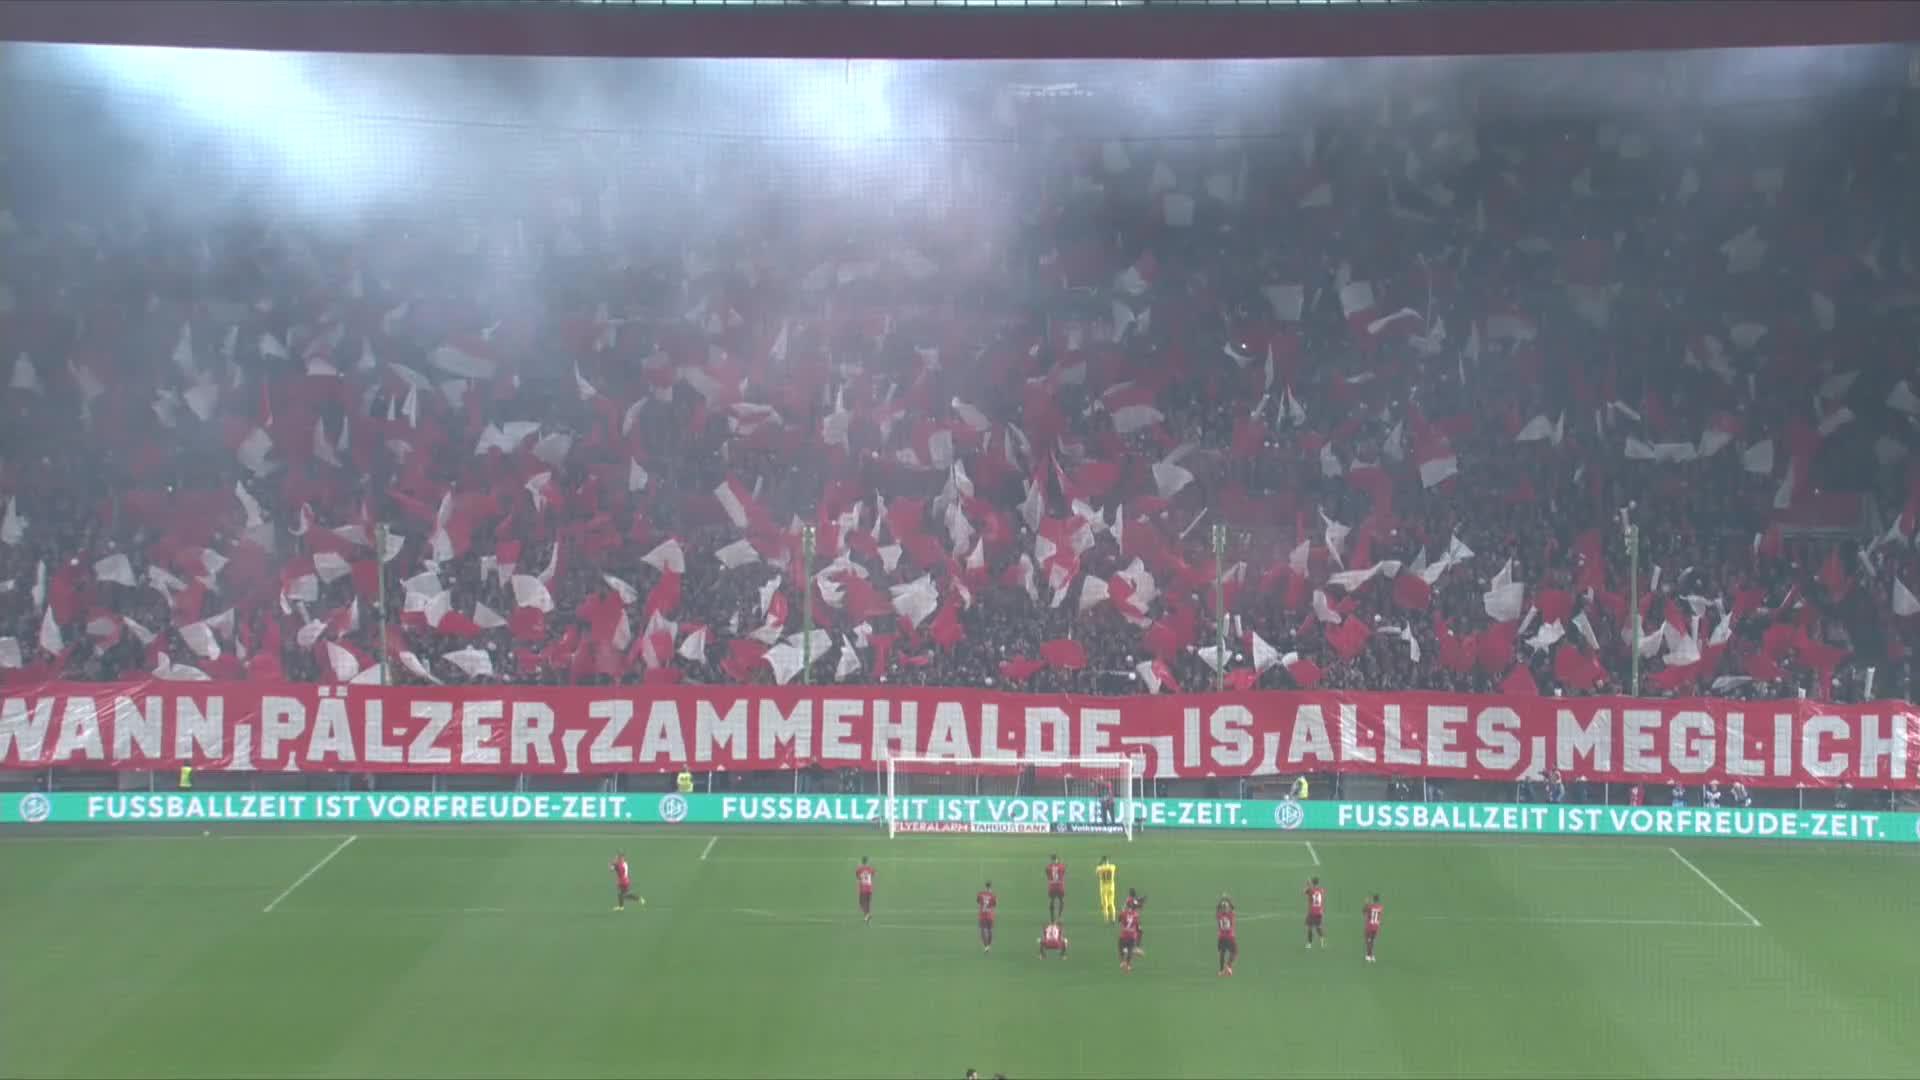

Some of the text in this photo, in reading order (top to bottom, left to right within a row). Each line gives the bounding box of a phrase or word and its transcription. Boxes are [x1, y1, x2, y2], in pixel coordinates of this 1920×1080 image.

[0, 695, 224, 762] WANN
[261, 685, 555, 766] PÄLZER
[1287, 702, 1521, 770] ALLES
[88, 796, 305, 818] FUSSBALLZEIT
[316, 796, 360, 818] IST
[367, 796, 632, 819] VORFREUDE-ZEIT.
[722, 798, 929, 821] FUSSBALLZEIT
[938, 798, 980, 821] IST
[1338, 804, 1886, 838] FUSSBALLZEIT IST VORFREUDE-ZEIT.
